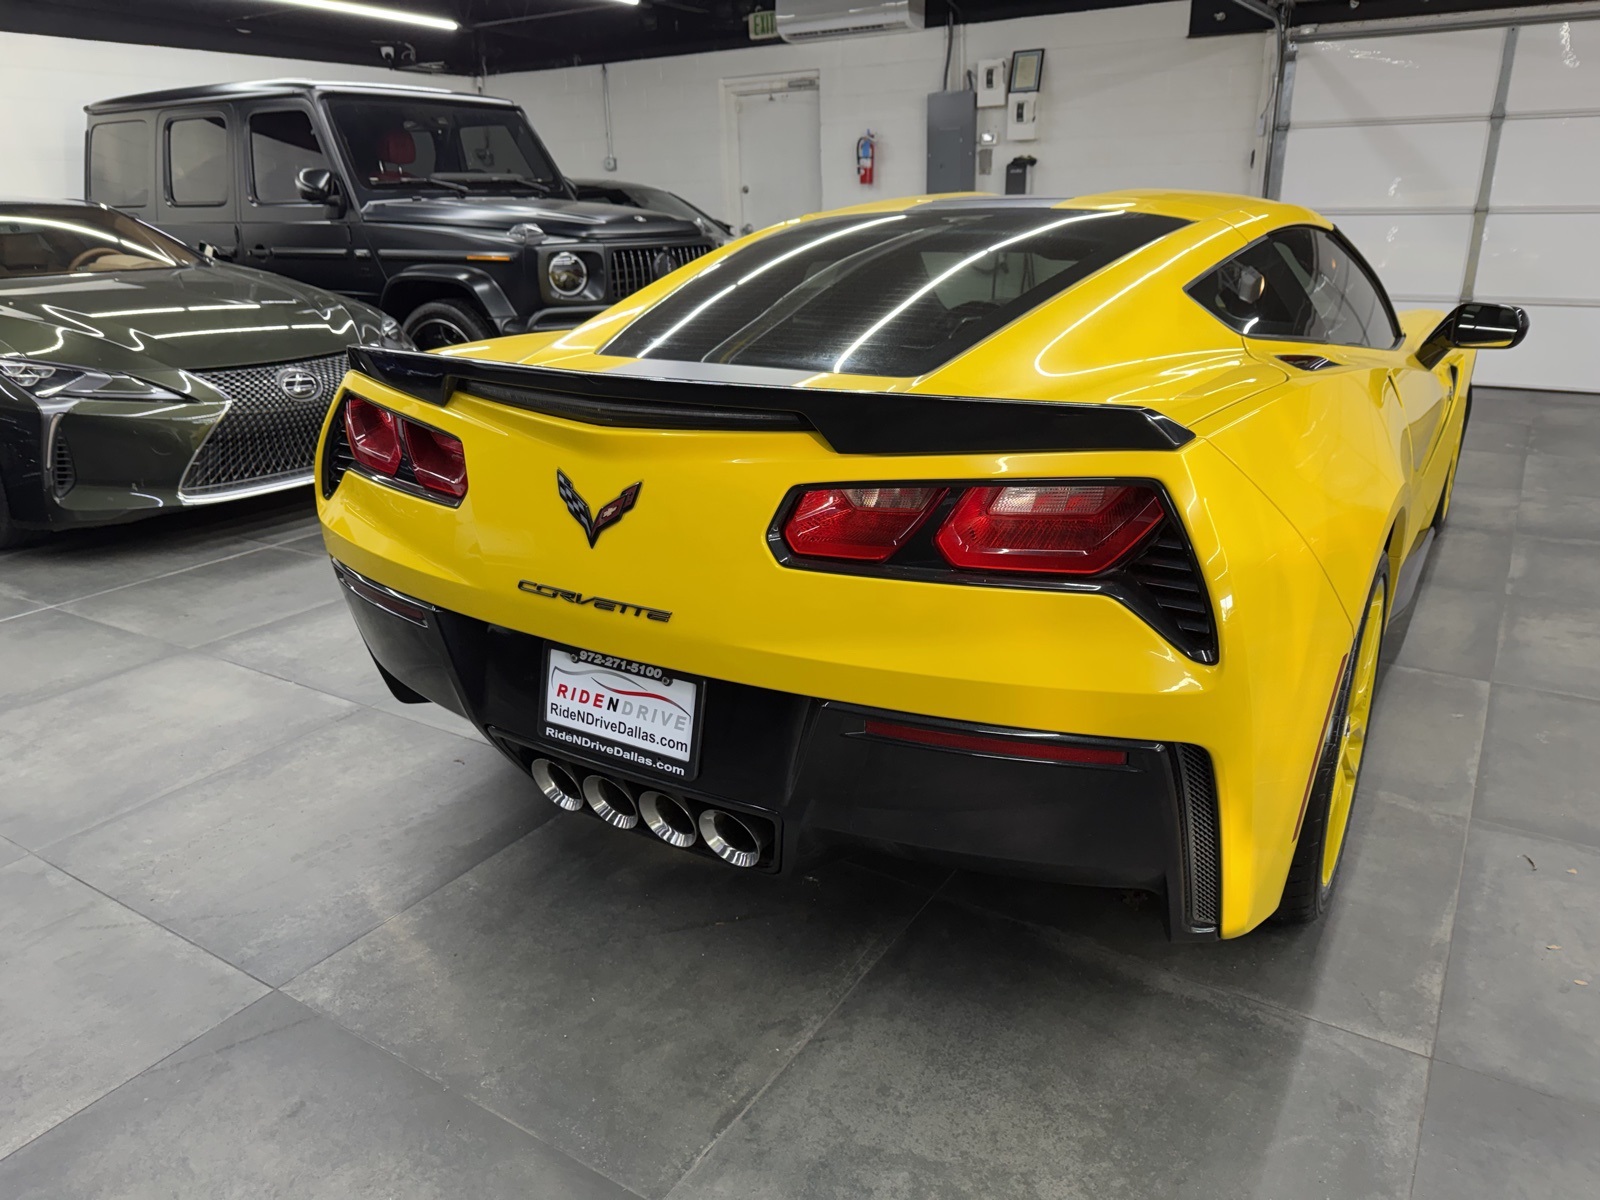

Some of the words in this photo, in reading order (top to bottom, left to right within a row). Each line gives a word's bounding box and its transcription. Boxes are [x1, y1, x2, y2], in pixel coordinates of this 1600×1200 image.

[753, 12, 776, 36] EXIT
[517, 579, 673, 623] CORVETTE
[579, 650, 663, 679] 972-271-5100
[550, 702, 688, 753] RideNDriveDallas.com
[545, 727, 685, 776] RideNDriveDallas.com
